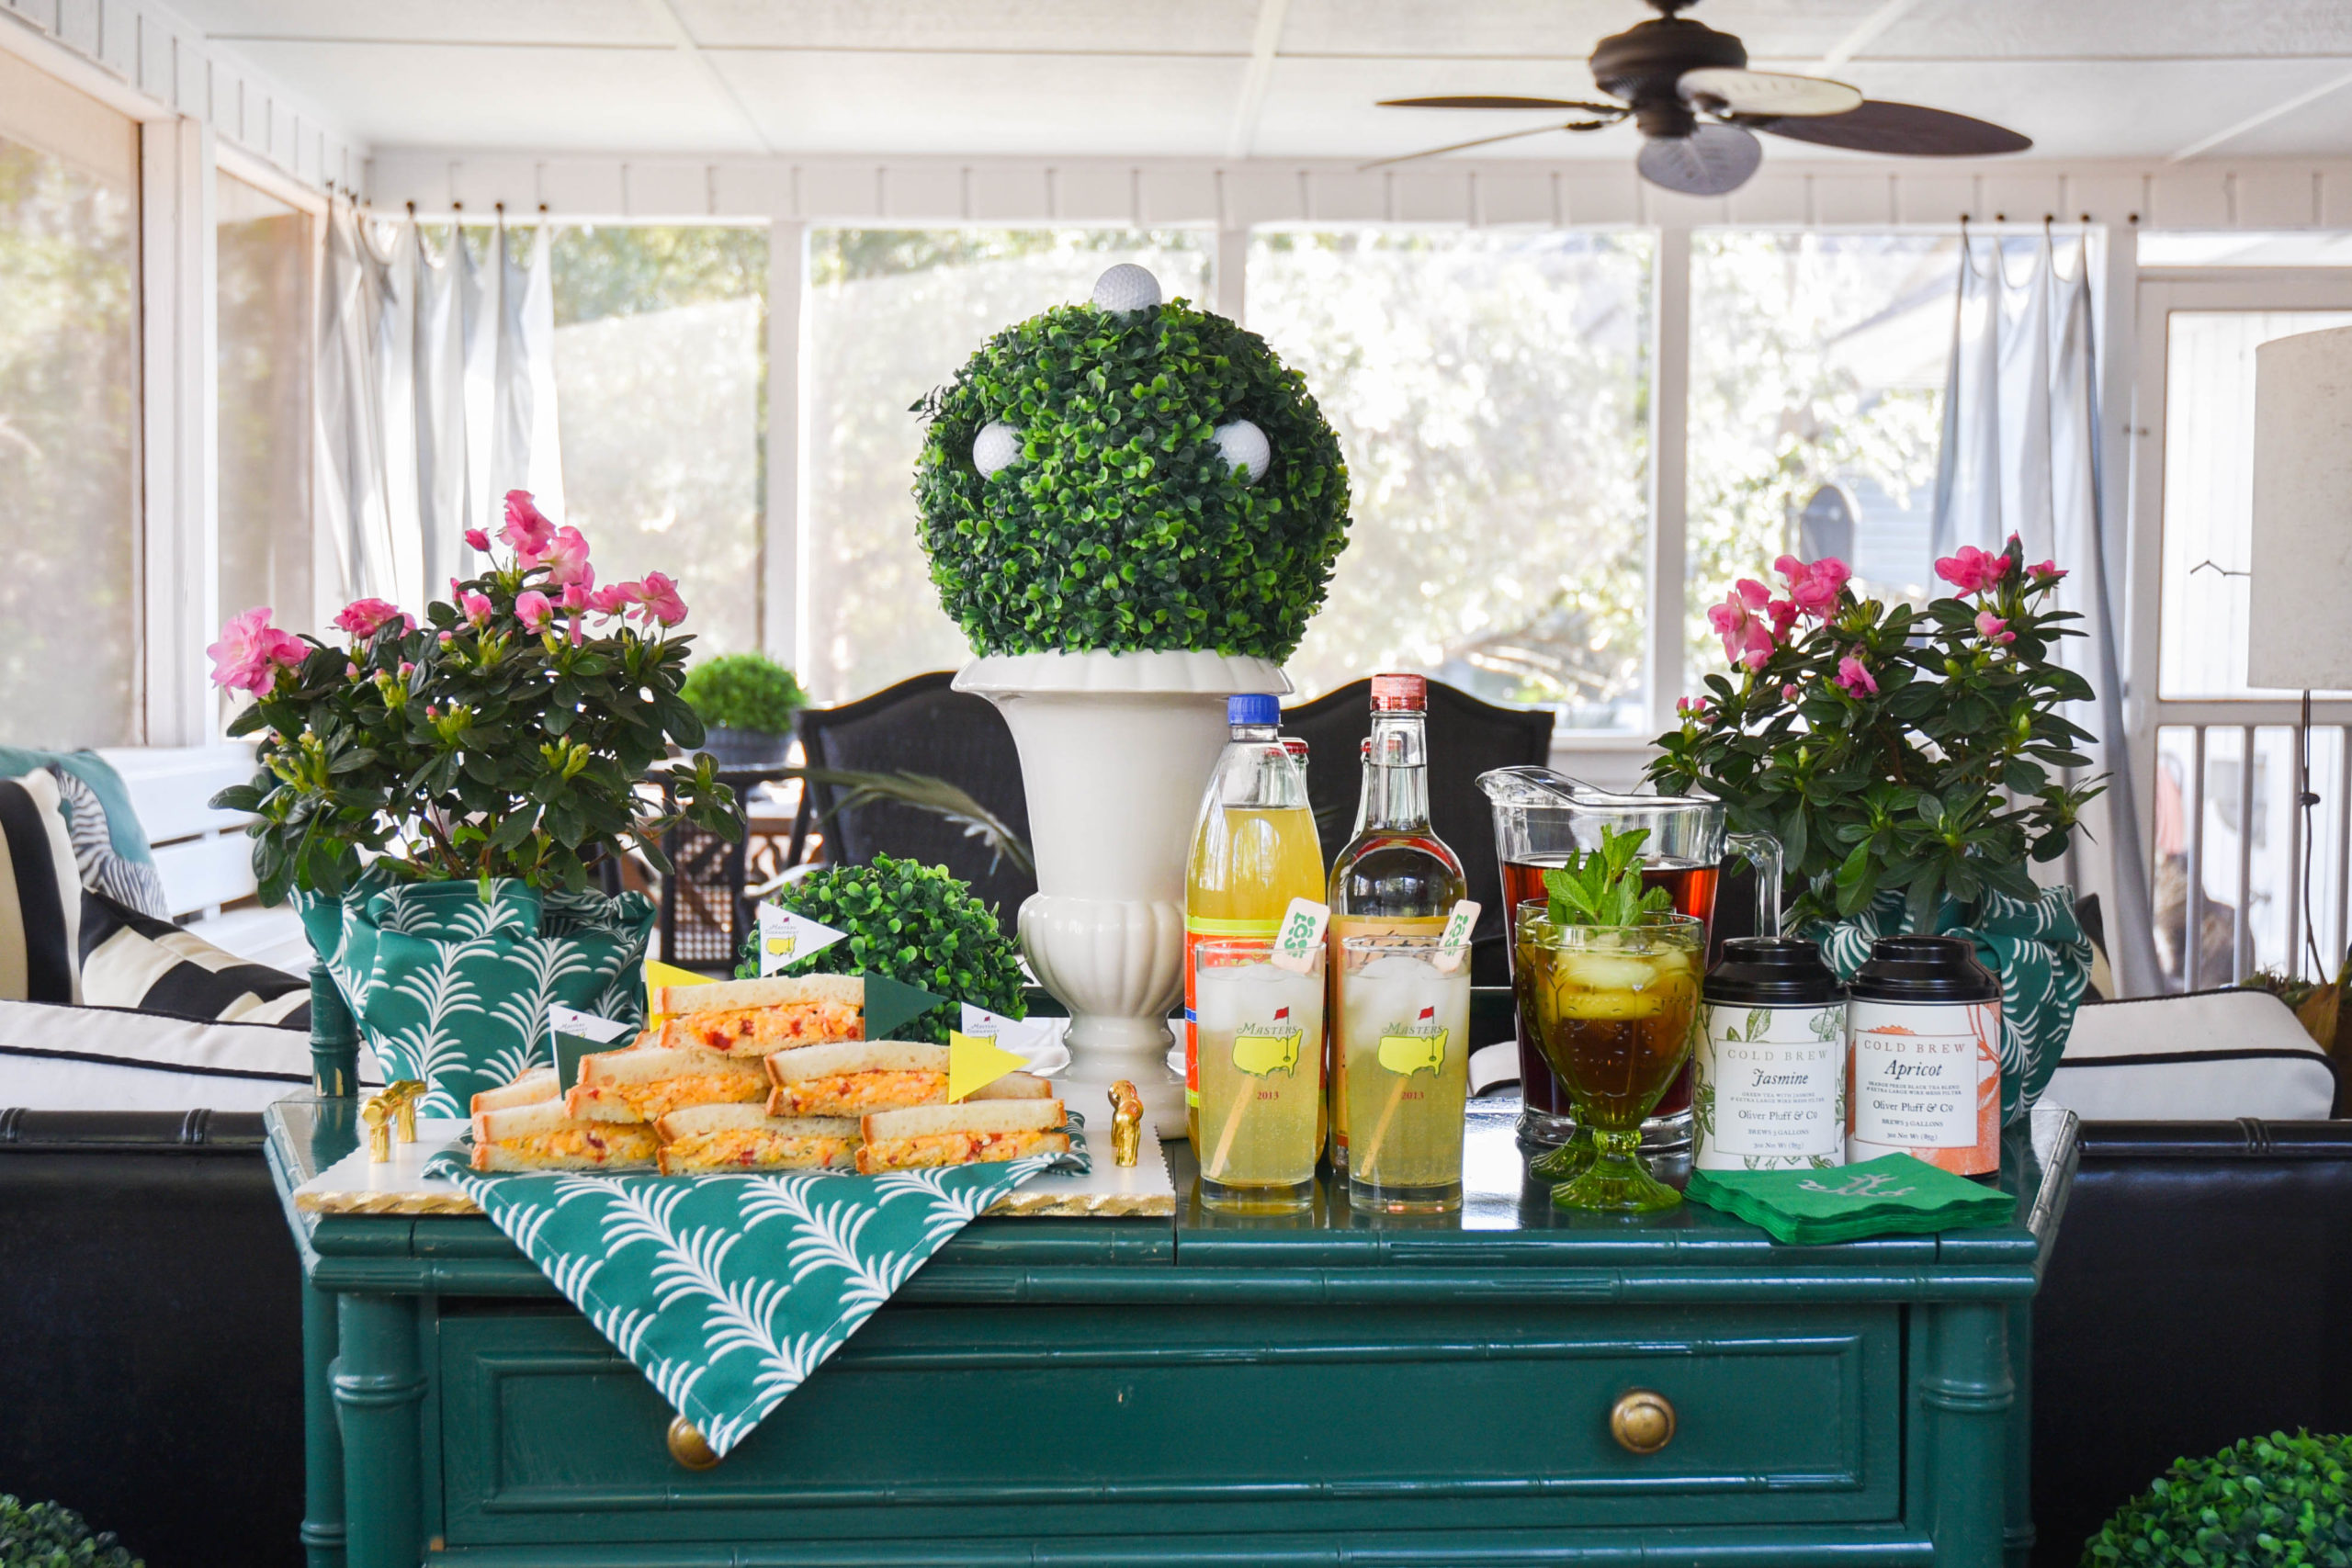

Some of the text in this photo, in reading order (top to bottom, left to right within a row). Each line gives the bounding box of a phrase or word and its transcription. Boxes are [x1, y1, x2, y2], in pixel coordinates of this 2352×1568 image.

[1864, 1040, 1966, 1054] COLD BREW
[1727, 1049, 1827, 1061] COLD BREW
[1884, 1059, 1943, 1080] Apricot
[1752, 1068, 1809, 1088] Jasmine
[1257, 1091, 1280, 1100] 2013
[1401, 1091, 1424, 1100] 2013
[1873, 1100, 1898, 1111] Oliver
[1901, 1102, 1925, 1111] Pluff
[1927, 1103, 1938, 1112] &
[1738, 1110, 1765, 1120] Oliver
[1769, 1111, 1792, 1121] Pluff
[1793, 1111, 1804, 1121] &
[1882, 1118, 1905, 1126] BREWS
